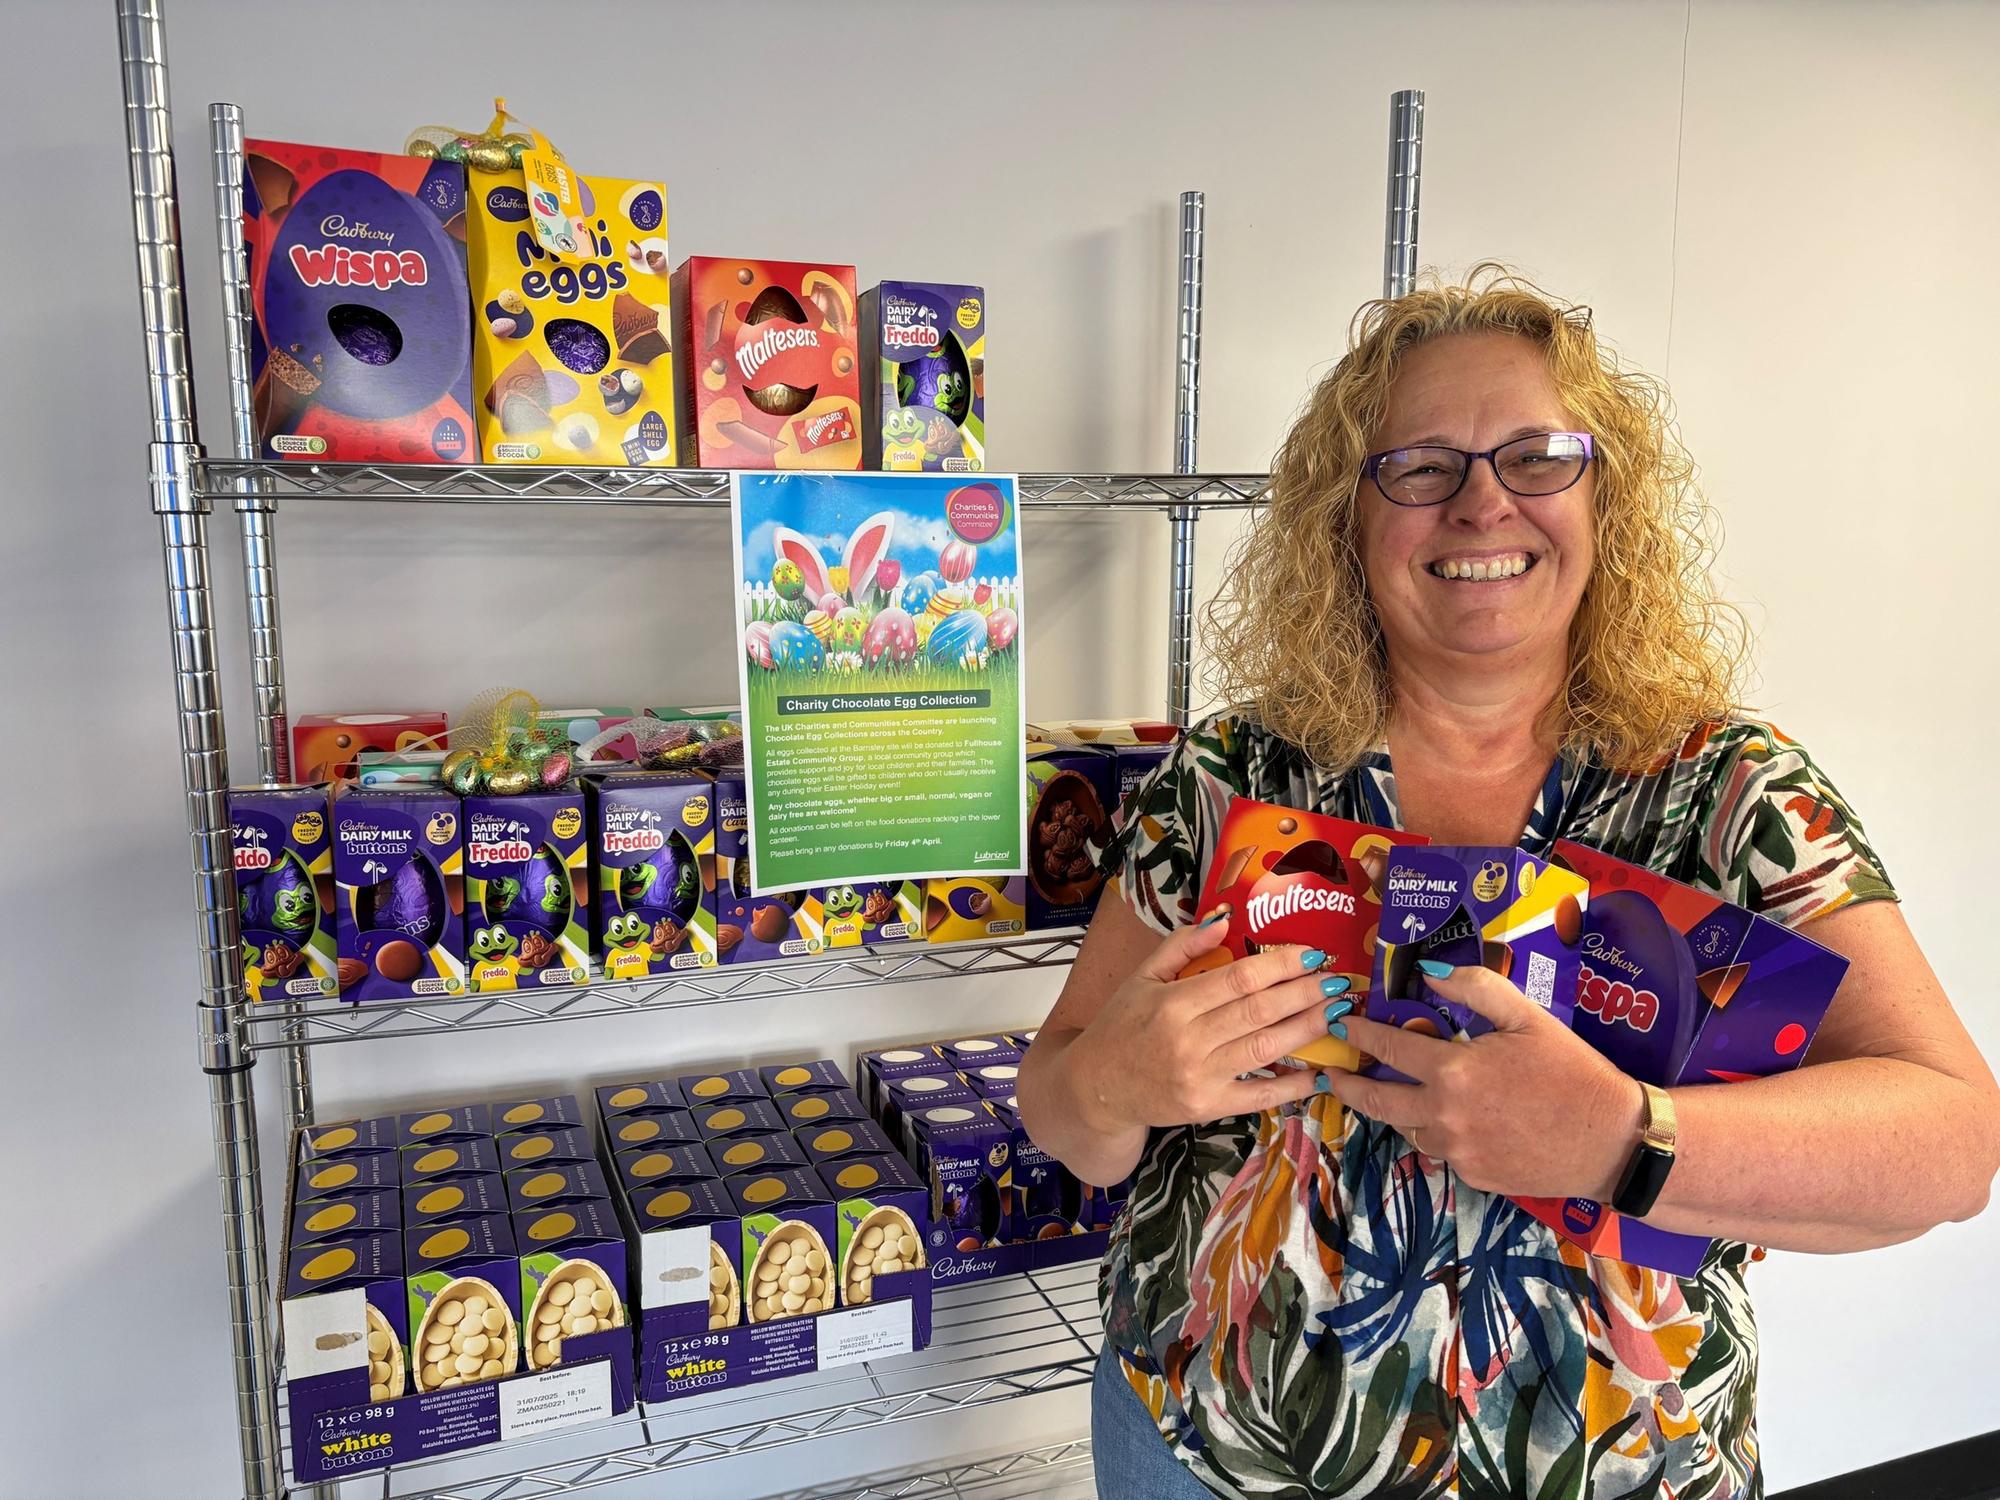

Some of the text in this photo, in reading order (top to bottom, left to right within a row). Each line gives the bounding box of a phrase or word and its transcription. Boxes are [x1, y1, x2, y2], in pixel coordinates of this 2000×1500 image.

[489, 193, 528, 209] Cadbur
[320, 214, 395, 246] Cadbury
[289, 243, 428, 291] Wispa
[521, 261, 628, 304] eggs
[887, 295, 916, 306] Cadbury
[887, 306, 918, 316] DAIRY
[887, 315, 912, 324] MILK
[885, 325, 938, 345] Freddo
[735, 327, 819, 380] Maltesers
[806, 411, 843, 446] Maltesers
[893, 451, 916, 462] Freddo
[954, 503, 994, 511] Charities &
[950, 511, 999, 519] Communities
[786, 694, 977, 712] Charity Chocolate Egg Collection
[765, 725, 779, 733] The
[781, 724, 793, 732] UK
[795, 722, 830, 731] Charities
[832, 721, 847, 729] and
[849, 719, 900, 729] Communities
[902, 718, 944, 727] Committee
[959, 716, 997, 725] launching
[765, 733, 804, 743] Chocolate
[806, 733, 822, 741] Egg
[824, 731, 869, 740] Collections
[870, 730, 896, 738] across
[912, 728, 944, 737] Country.
[766, 749, 776, 757] All
[777, 749, 794, 757] eggs
[796, 746, 828, 756] collected
[853, 743, 885, 753] Barnsley
[901, 742, 912, 750] will
[925, 741, 954, 749] donated
[964, 739, 1002, 747] Fullhouse
[766, 758, 790, 767] Estate
[792, 755, 836, 766] Community
[874, 752, 891, 760] local
[893, 751, 931, 760] community
[933, 750, 953, 758] group
[767, 789, 781, 797] any
[782, 787, 805, 796] during
[806, 785, 822, 793] their
[824, 784, 848, 792] Easter
[850, 782, 877, 791] Holiday
[605, 803, 638, 814] Cadbury
[719, 796, 746, 808] Cadbu
[768, 803, 783, 811] Any
[785, 799, 823, 810] chocolate
[824, 798, 845, 807] eggs,
[847, 796, 879, 804] whether
[880, 795, 893, 803] big
[894, 794, 902, 802] or
[905, 793, 927, 801] small,
[929, 792, 957, 800] normal,
[959, 791, 983, 799] vegan
[470, 812, 505, 824] Cadbury
[606, 812, 641, 823] DAIRY
[720, 807, 747, 817] DAIR
[768, 812, 788, 821] dairy
[789, 810, 804, 818] free
[820, 807, 857, 816] welcome!
[339, 819, 379, 832] Cadbury
[471, 823, 507, 833] DAIRY
[606, 821, 634, 831] MILK
[340, 829, 413, 841] DAIRY MILK
[472, 832, 500, 841] MILK
[605, 831, 662, 851] Freddo
[346, 841, 408, 855] buttons
[470, 842, 530, 861] Freddo
[769, 849, 794, 859] Please
[795, 847, 813, 856] bring
[823, 845, 836, 853] any
[837, 842, 873, 851] donations
[874, 841, 883, 850] by
[885, 839, 909, 848] Friday
[922, 837, 943, 846] April.
[974, 851, 1010, 860] Lubrizol
[1389, 864, 1427, 879] Cadbury
[1388, 879, 1458, 893] DAIRY MILK
[1391, 891, 1451, 909] buttons
[1246, 882, 1356, 934] Maltesers
[833, 923, 855, 934] Freddo
[616, 955, 641, 966] Freddo
[1581, 932, 1644, 981] Cadbury
[482, 967, 508, 979] Freddo
[1574, 966, 1660, 1033] ispa
[933, 1122, 995, 1135] HAPPY EASTER
[960, 1158, 980, 1169] MILK
[931, 1256, 997, 1280] Cadbury
[664, 1343, 679, 1354] 12
[704, 1336, 719, 1347] 98
[721, 1335, 729, 1346] g
[665, 1353, 701, 1366] Cadbury
[666, 1358, 727, 1380] white
[666, 1371, 728, 1393] buttons
[420, 1396, 441, 1404] HOLLOW
[441, 1392, 457, 1401] WHITE
[457, 1387, 484, 1398] CHOCOLATE
[420, 1392, 495, 1412] CONTAINING WHITE CHOCOLATE
[516, 1392, 559, 1407] 31/07/2025
[317, 1416, 334, 1429] 12
[365, 1407, 383, 1420] 98
[386, 1406, 395, 1418] g
[437, 1407, 460, 1415] BUTTONS
[320, 1427, 362, 1443] Cadbury
[321, 1431, 392, 1456] white
[321, 1446, 394, 1471] buttons
